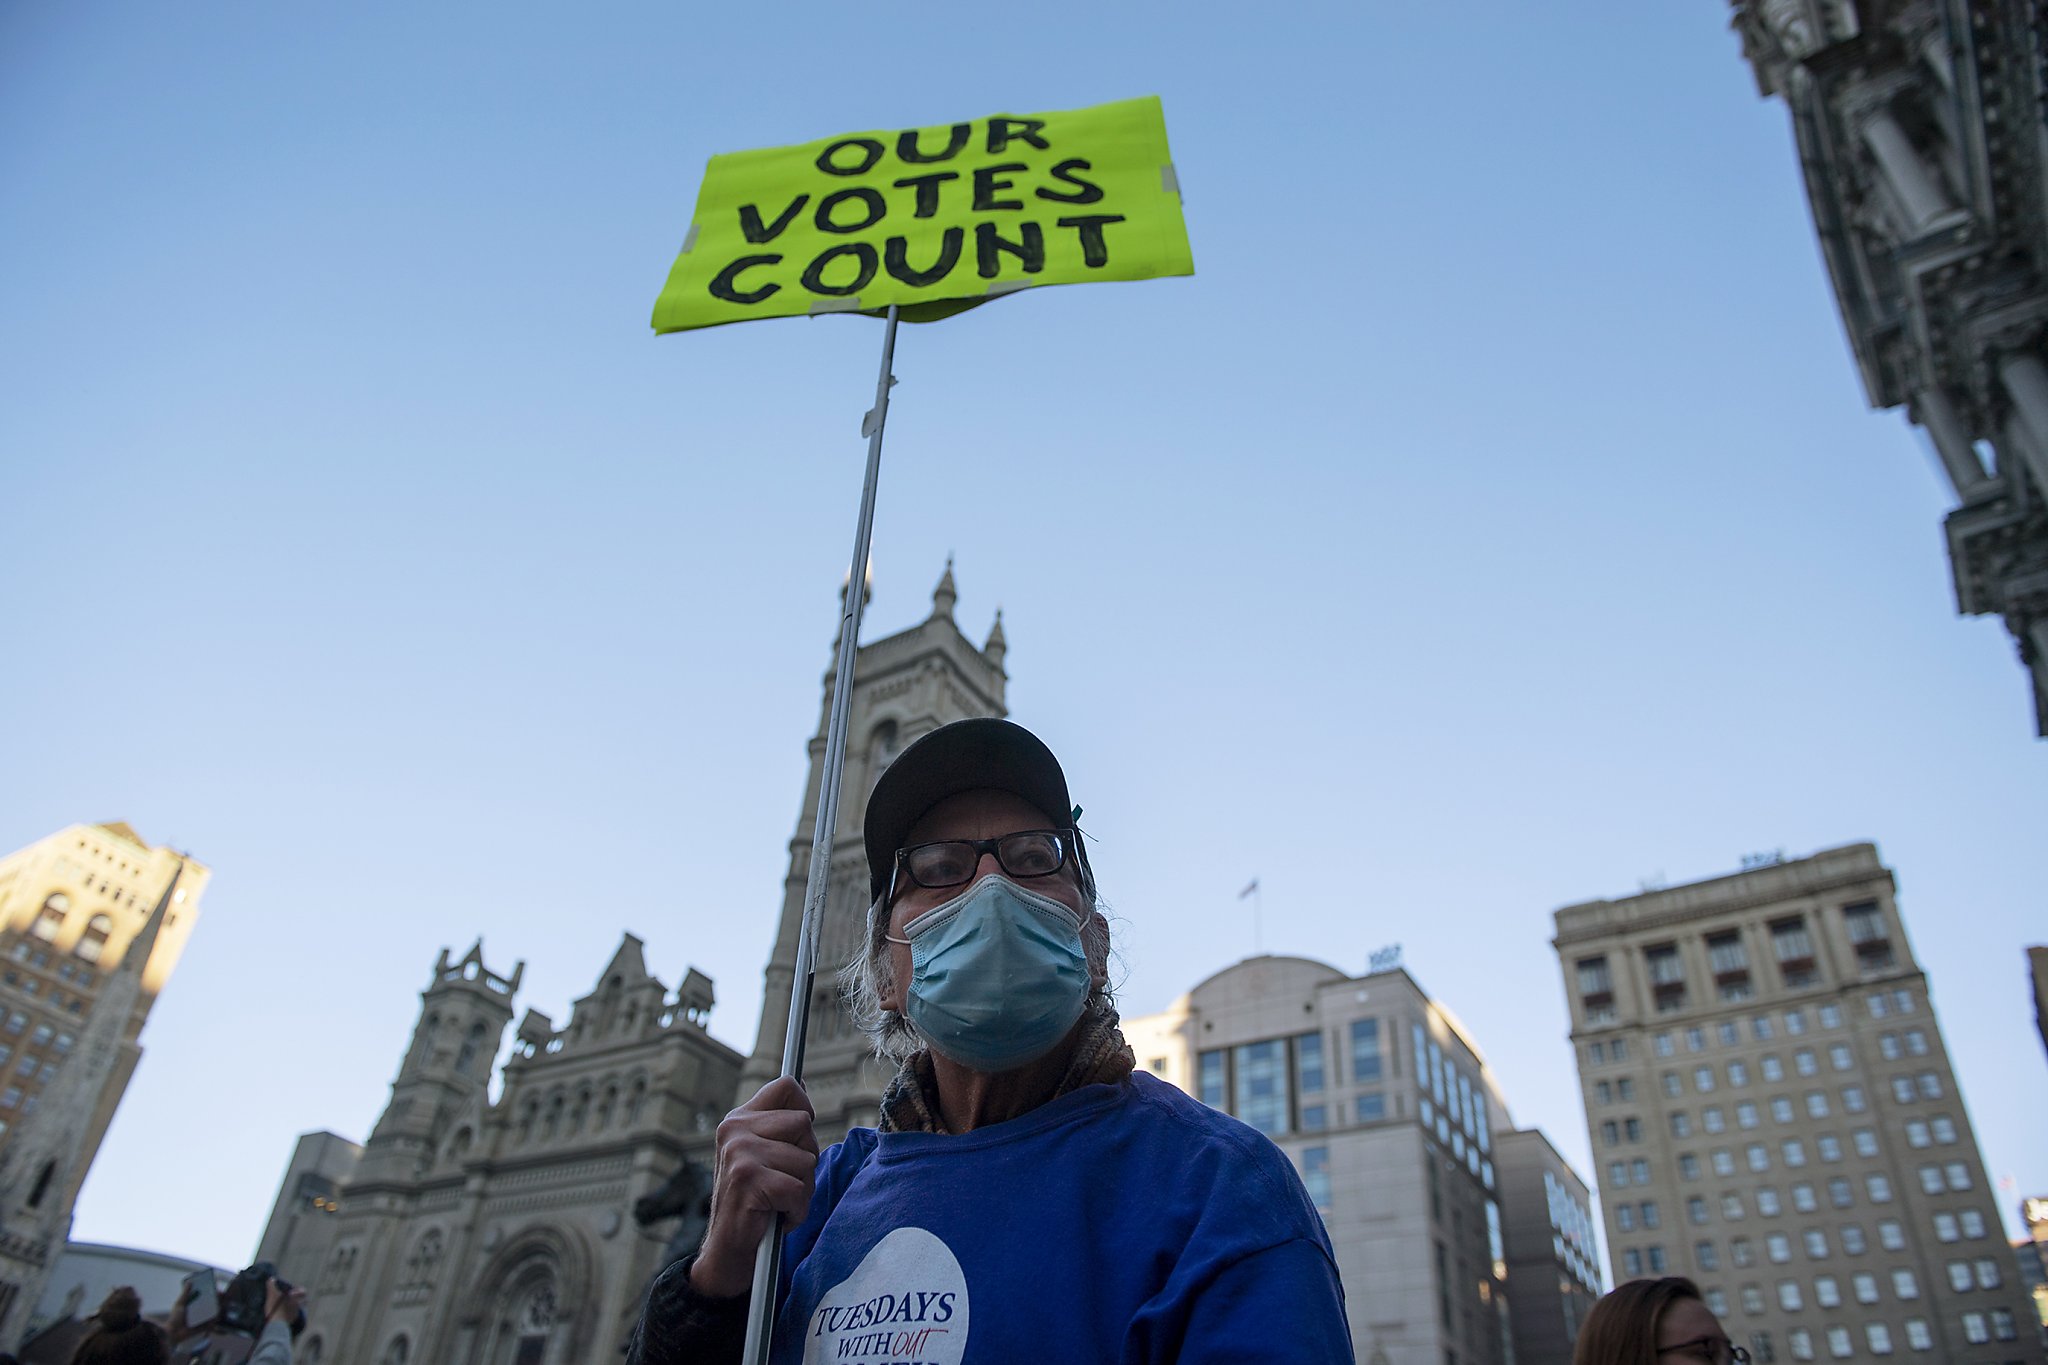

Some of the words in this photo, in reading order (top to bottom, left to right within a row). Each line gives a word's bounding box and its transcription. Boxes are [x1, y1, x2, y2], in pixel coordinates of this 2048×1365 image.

[814, 117, 1050, 176] OUR
[737, 158, 1105, 243] VOTES
[708, 214, 1126, 304] COUNT
[815, 1291, 957, 1337] TUESDAYS
